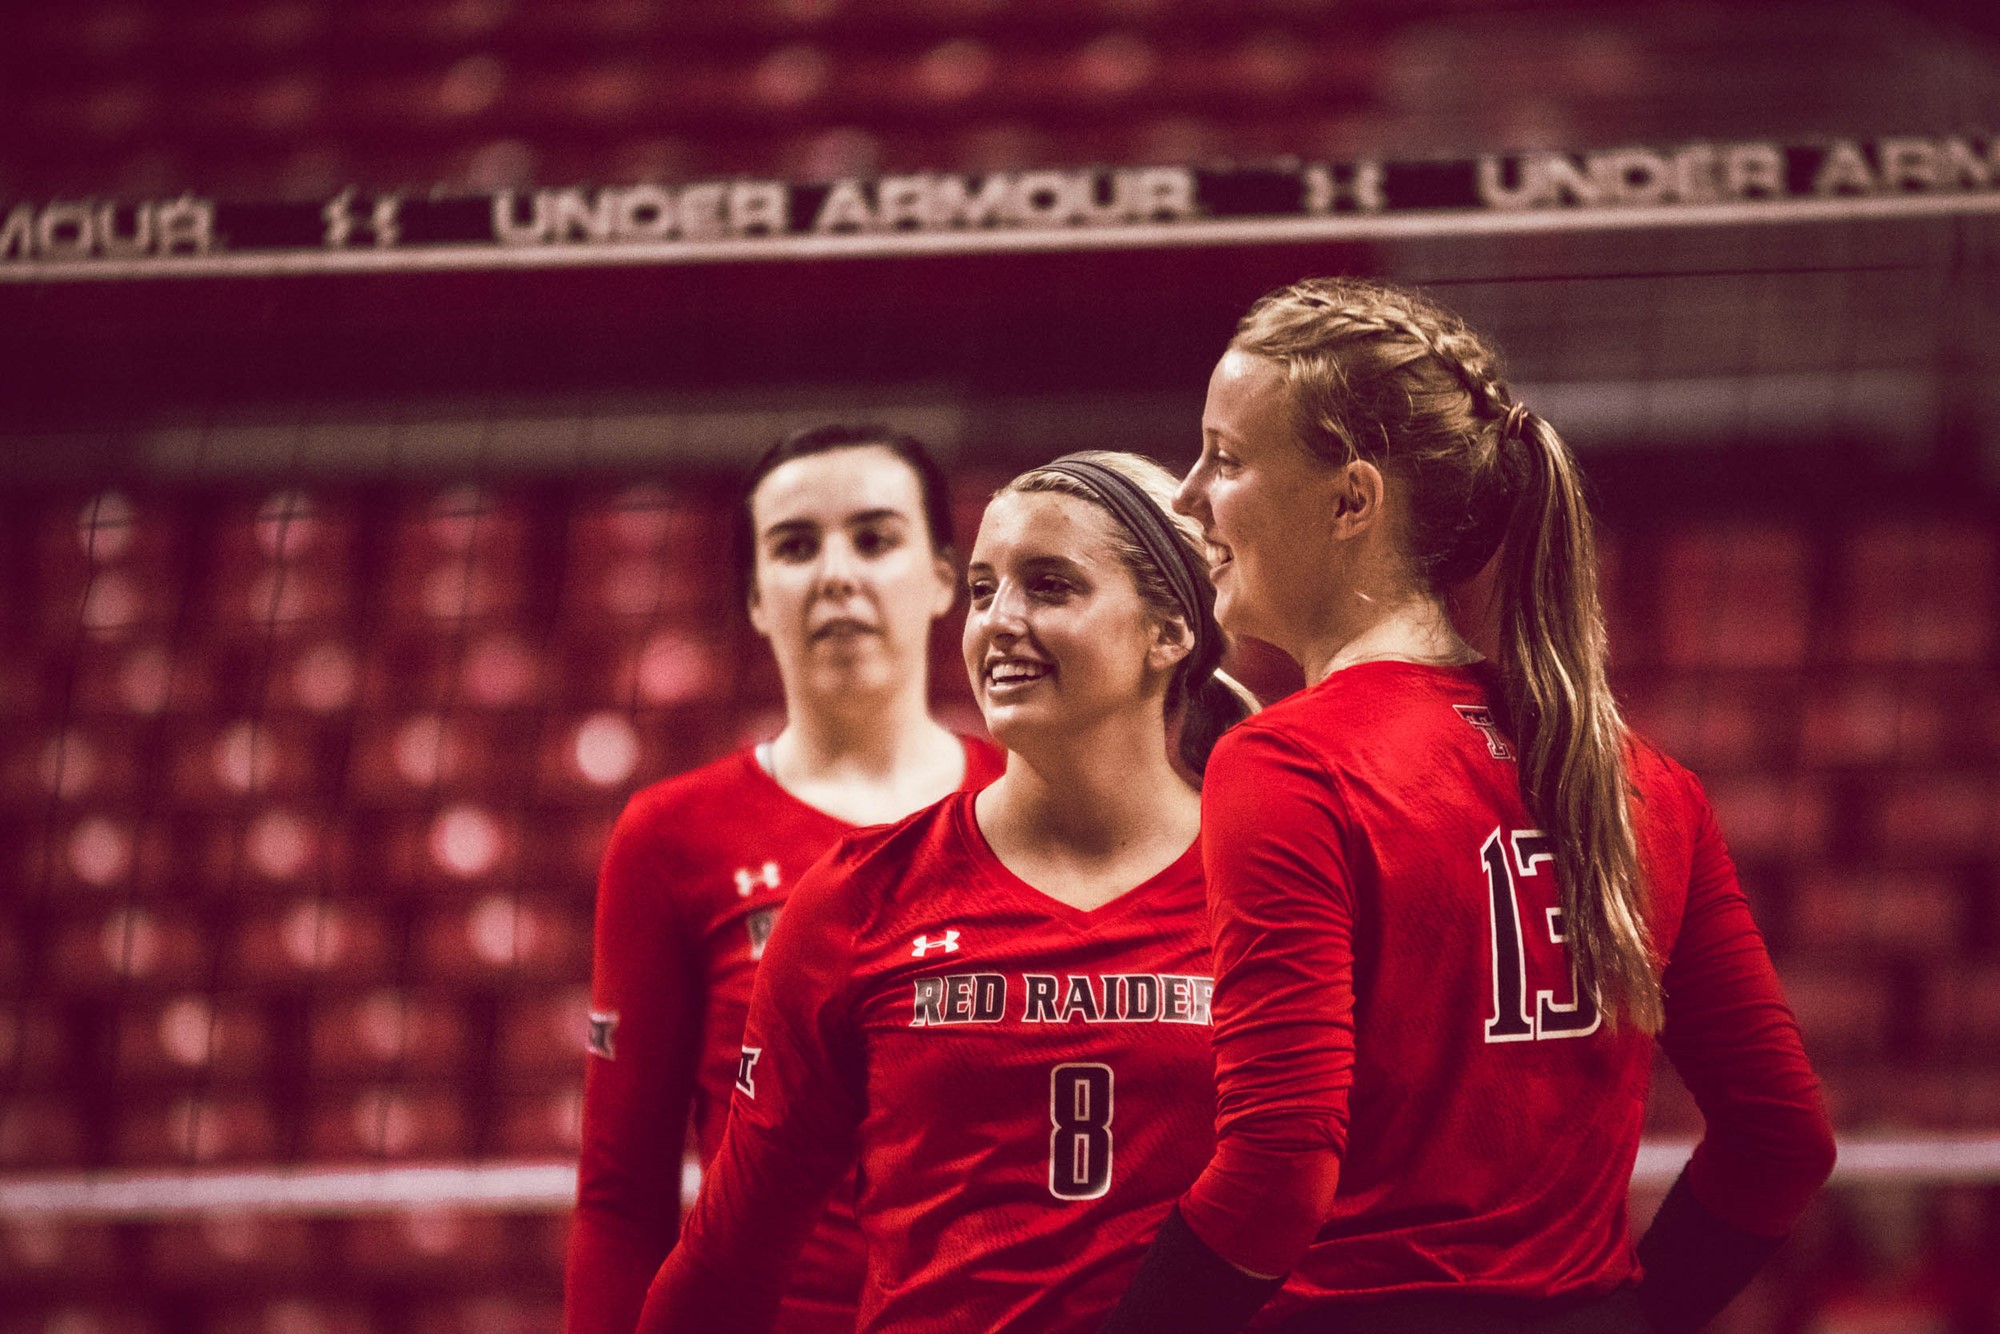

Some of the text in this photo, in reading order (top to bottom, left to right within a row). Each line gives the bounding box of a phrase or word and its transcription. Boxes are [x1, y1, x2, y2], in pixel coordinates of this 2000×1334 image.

[492, 167, 1196, 246] UNDER ARMOUR
[1478, 142, 1783, 208] UNDER
[1480, 825, 1602, 1043] 13
[909, 973, 1007, 1027] RED
[1049, 1062, 1115, 1201] 8
